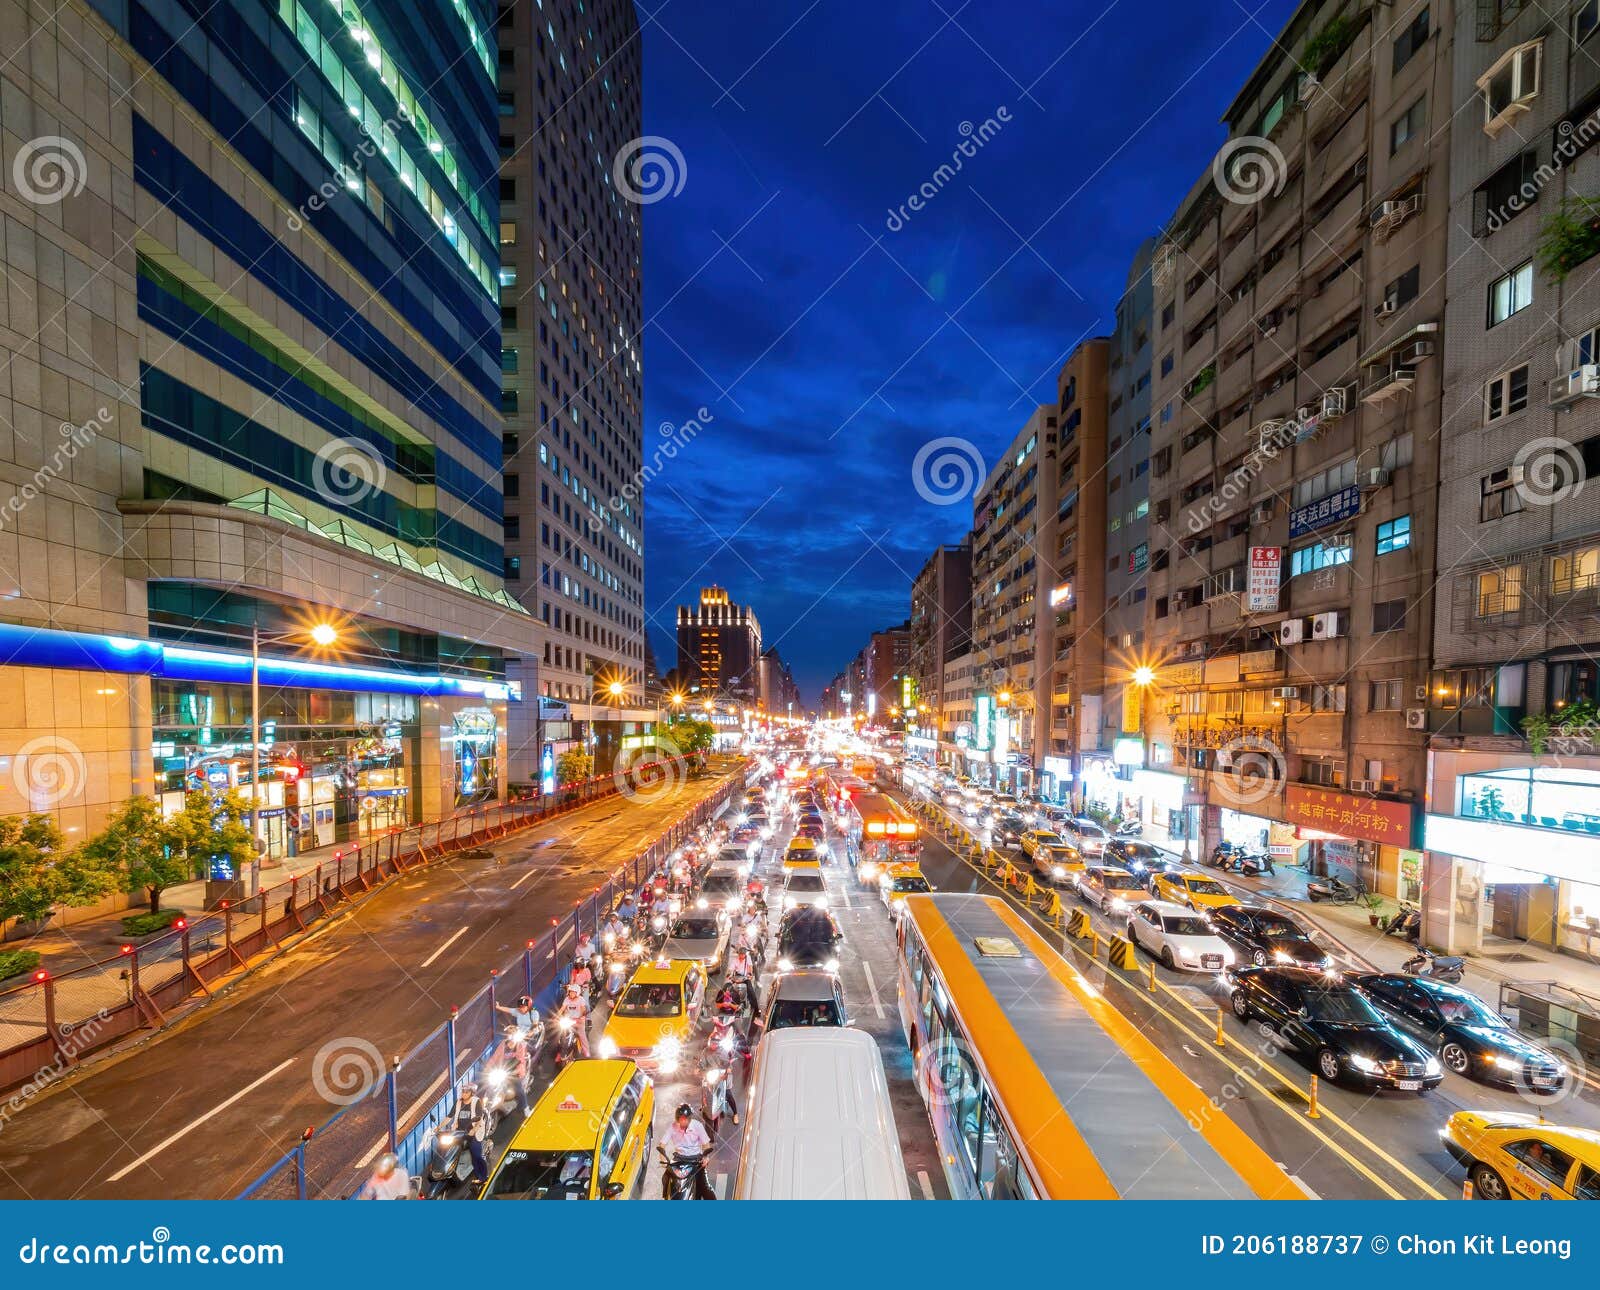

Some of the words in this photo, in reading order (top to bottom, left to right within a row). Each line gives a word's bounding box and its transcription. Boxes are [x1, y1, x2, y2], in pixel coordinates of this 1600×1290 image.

[1298, 802, 1390, 832] 越南牛肉河粉
